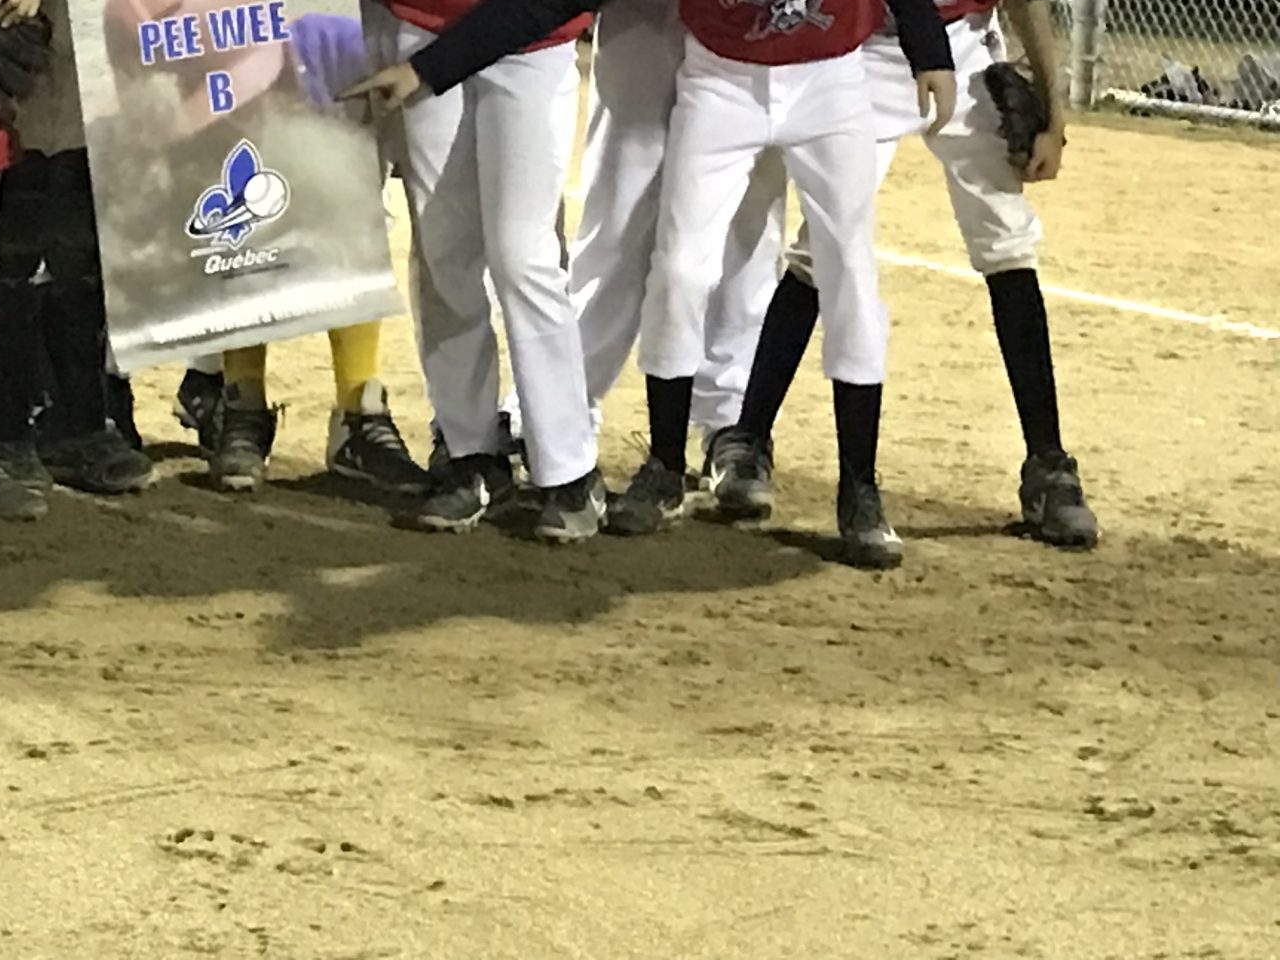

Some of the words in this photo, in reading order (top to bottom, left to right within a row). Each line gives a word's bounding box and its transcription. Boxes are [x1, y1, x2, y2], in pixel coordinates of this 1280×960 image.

[138, 14, 204, 65] PEE
[207, 1, 291, 50] WEE
[206, 71, 234, 115] B
